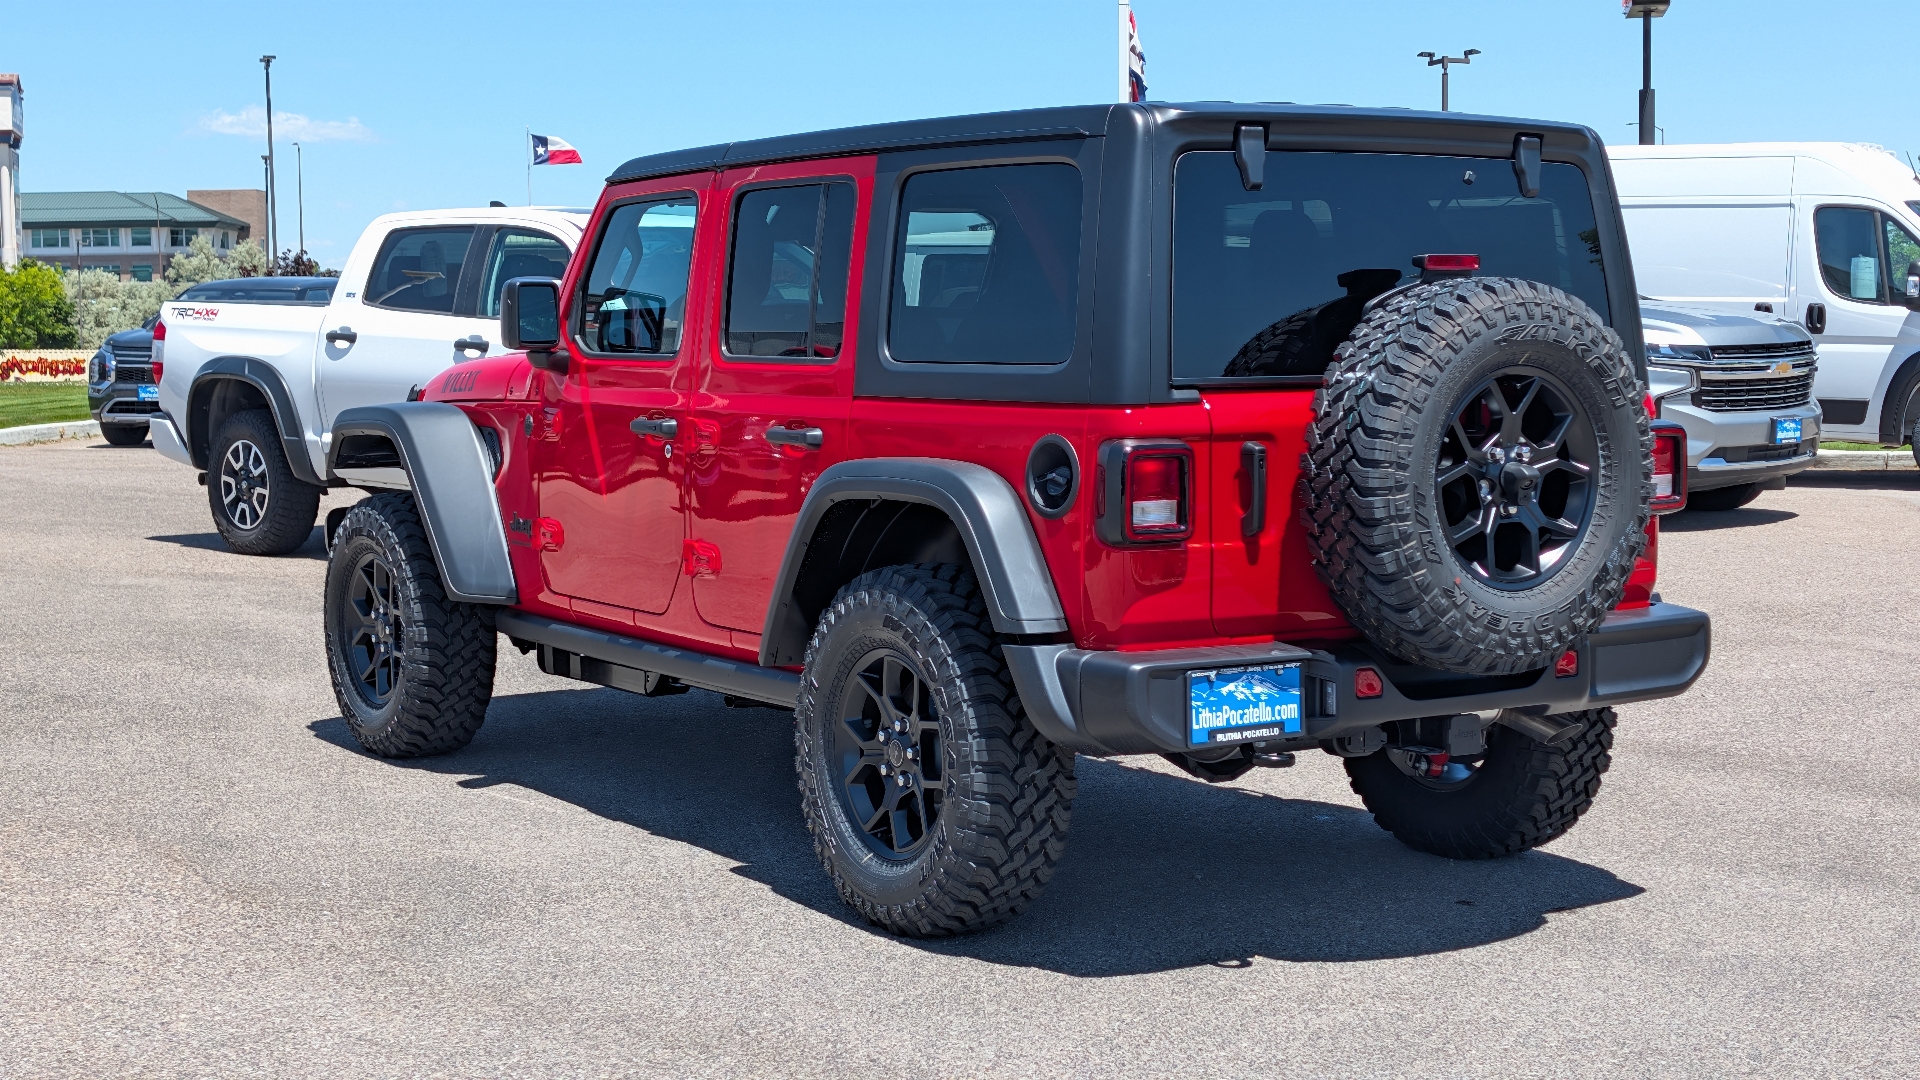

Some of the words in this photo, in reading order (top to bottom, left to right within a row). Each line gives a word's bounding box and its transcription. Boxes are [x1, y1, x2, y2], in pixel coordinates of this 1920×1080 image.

[1493, 323, 1627, 411] FALKEN
[510, 511, 532, 539] Jeep
[1192, 702, 1298, 730] LithiaPocatello.com
[1243, 727, 1279, 739] POCATELLO
